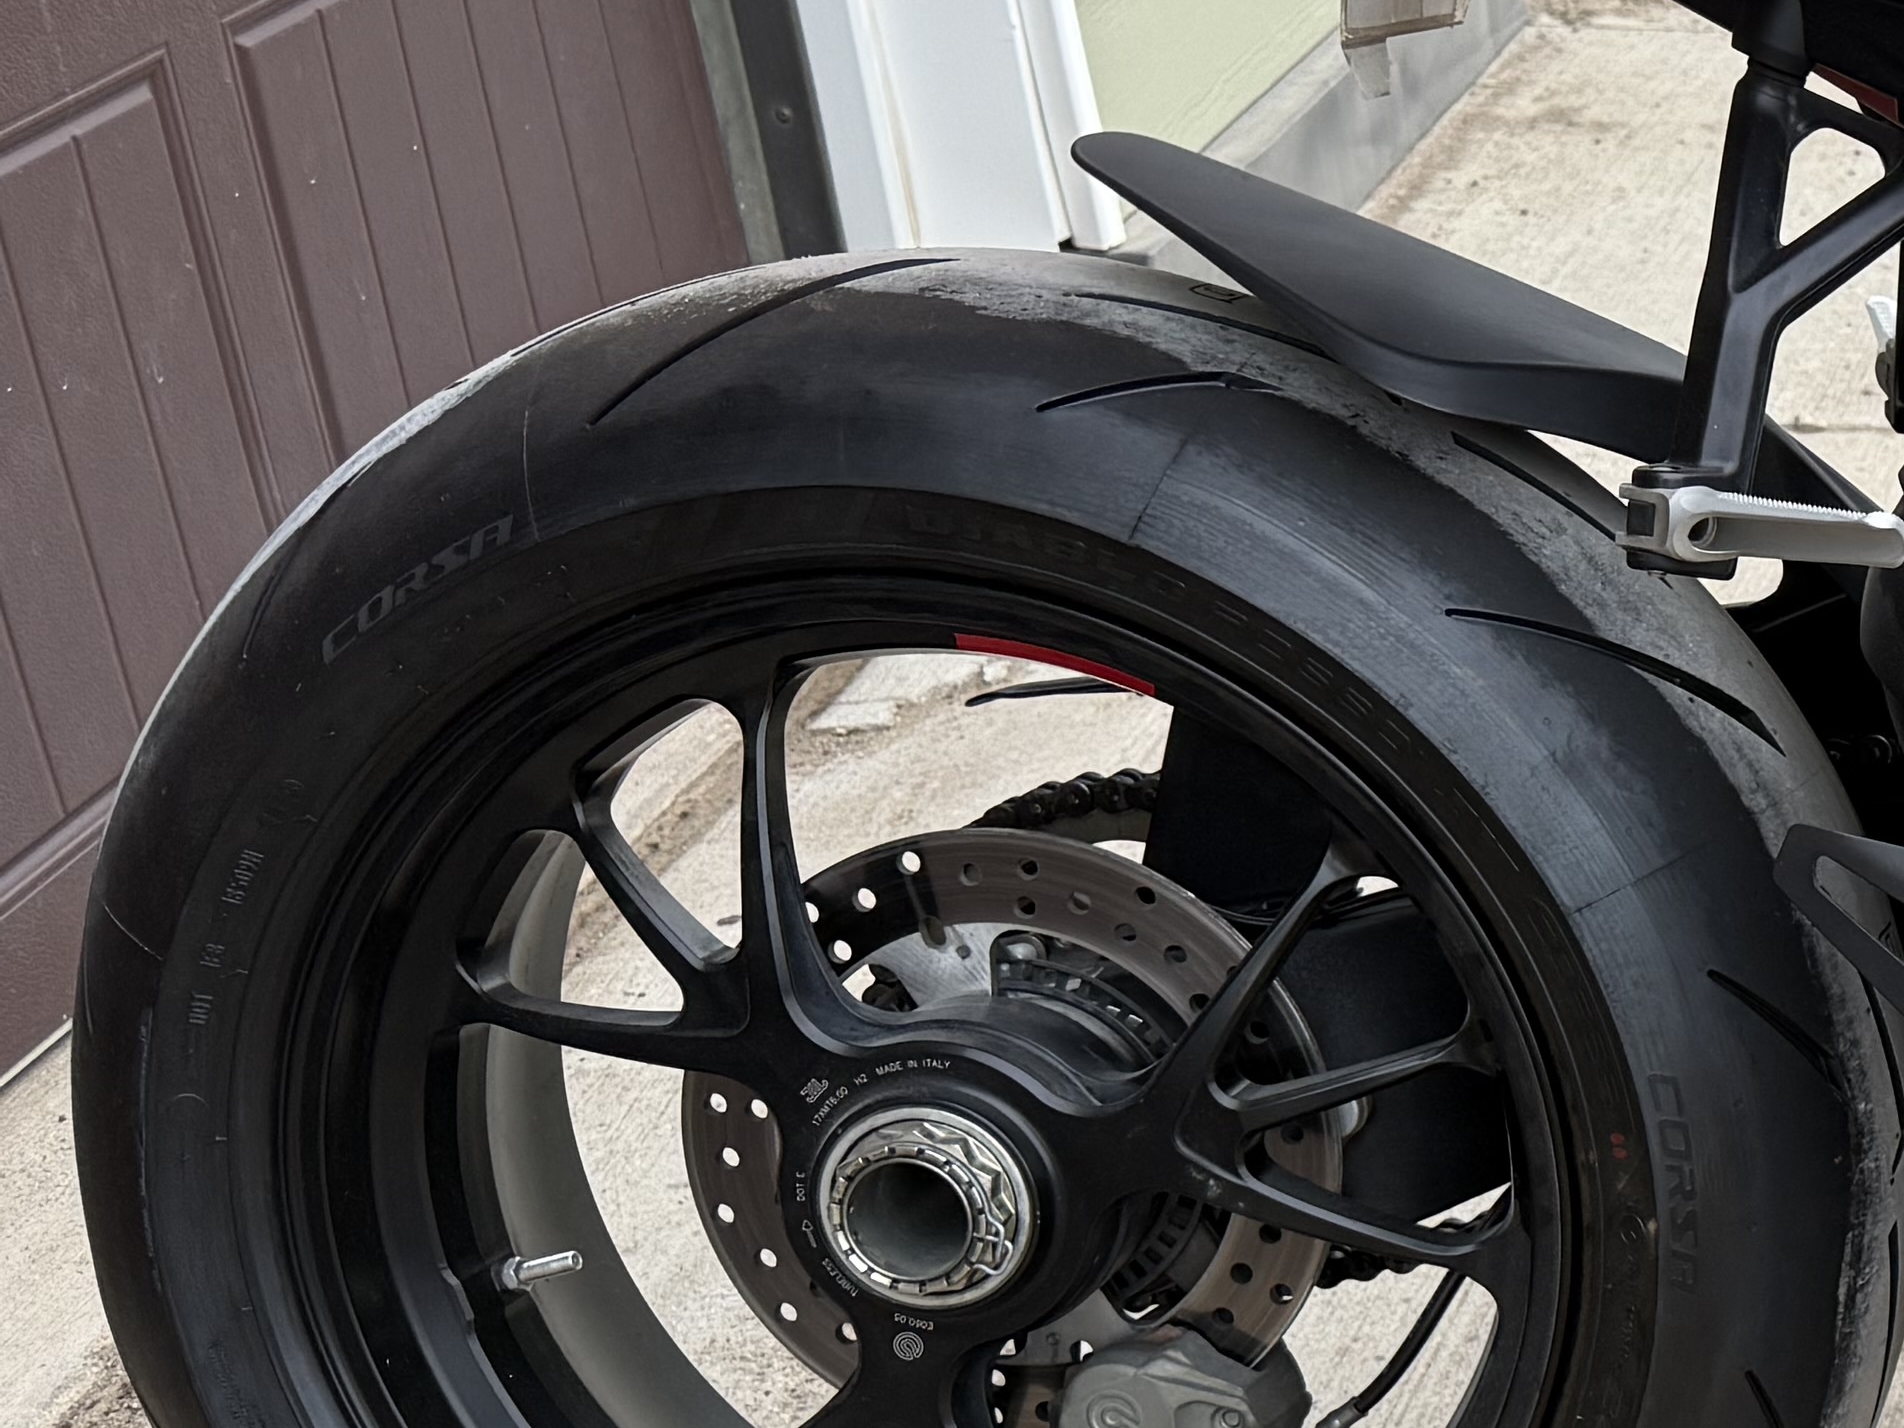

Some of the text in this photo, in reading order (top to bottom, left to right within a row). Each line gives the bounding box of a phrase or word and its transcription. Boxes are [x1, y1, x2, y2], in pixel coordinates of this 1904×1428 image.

[320, 513, 518, 667] CORSA
[875, 1059, 904, 1076] MADE
[921, 1058, 952, 1070] ITALY
